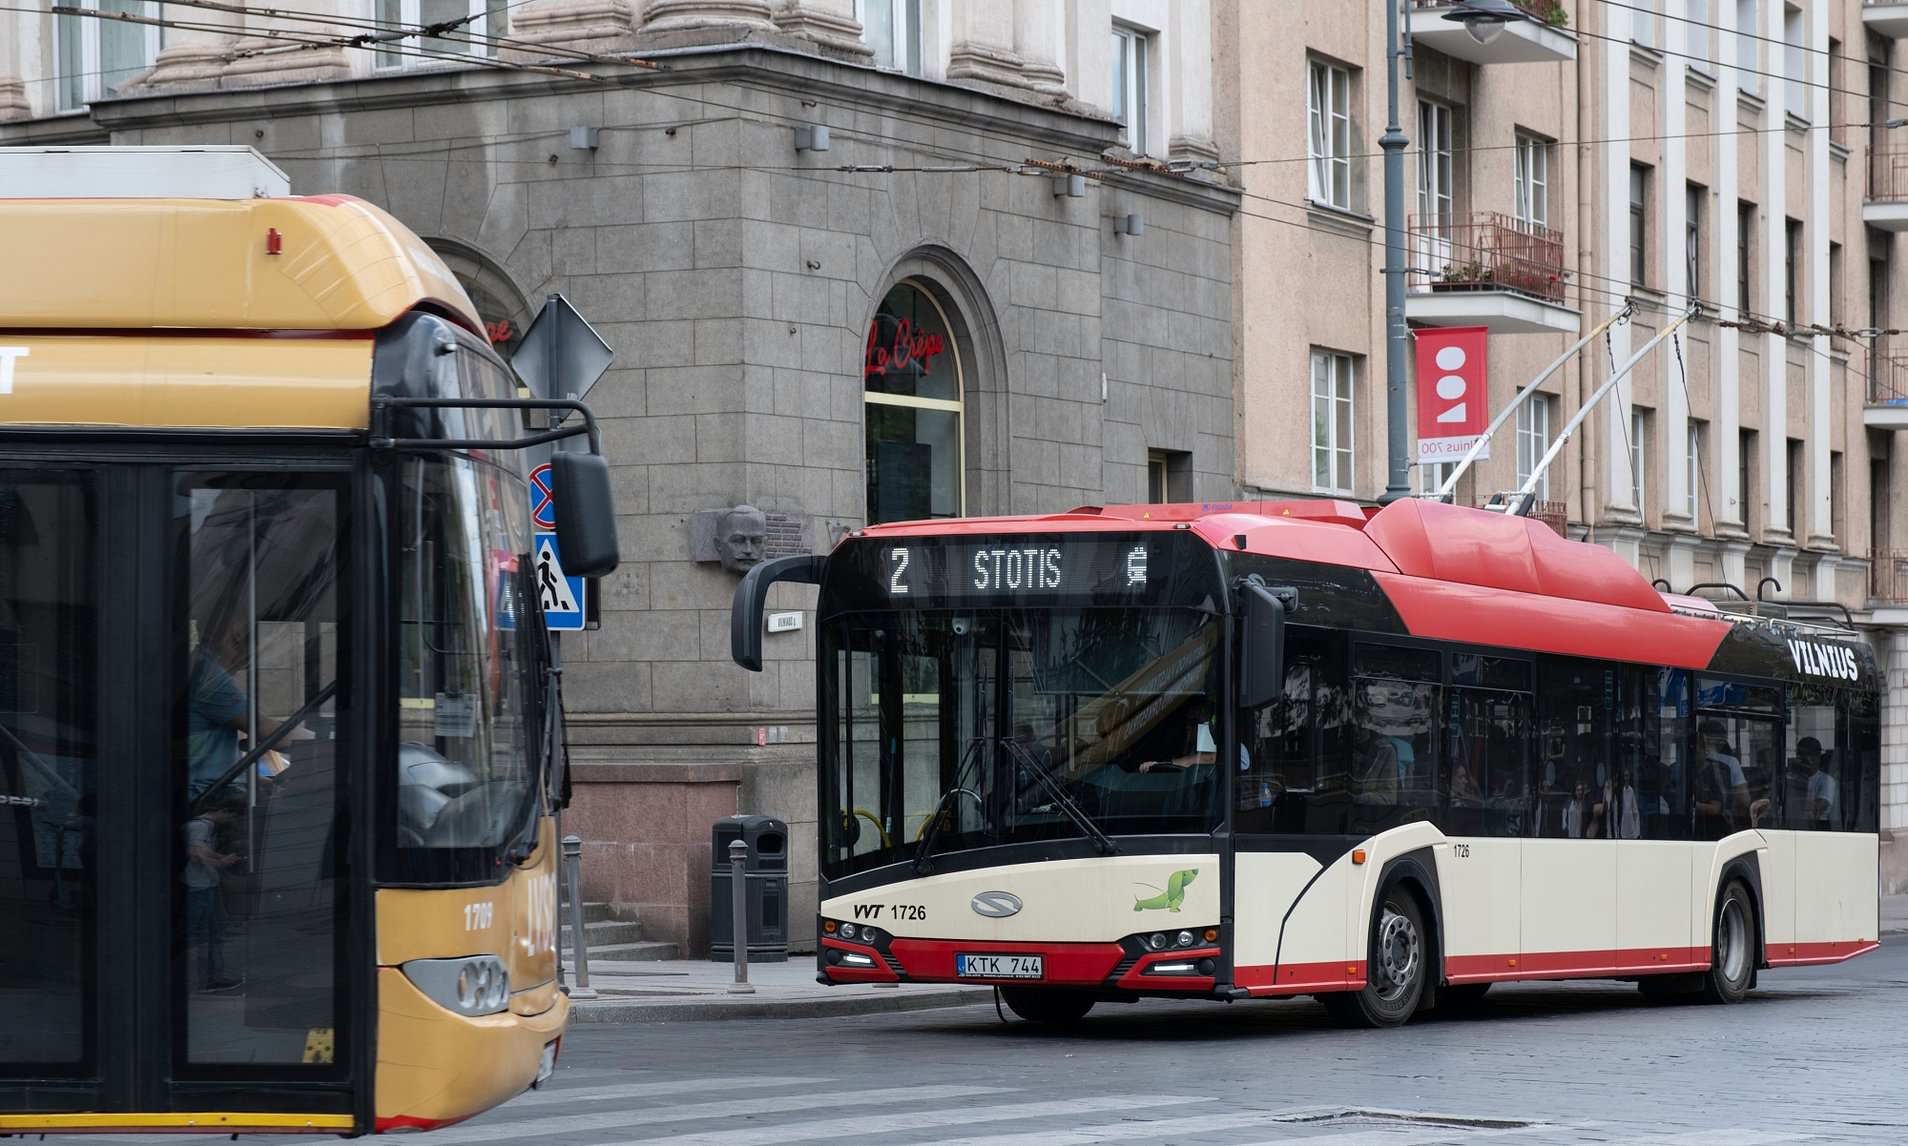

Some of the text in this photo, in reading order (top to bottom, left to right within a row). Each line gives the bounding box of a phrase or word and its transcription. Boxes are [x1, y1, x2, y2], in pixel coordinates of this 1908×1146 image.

[890, 547, 1061, 593] 2 STOTIS
[1787, 639, 1858, 681] VILNIUS
[1454, 844, 1470, 858] 1726
[891, 904, 927, 920] 1726
[967, 957, 1000, 973] KTK
[1011, 958, 1040, 973] 744
